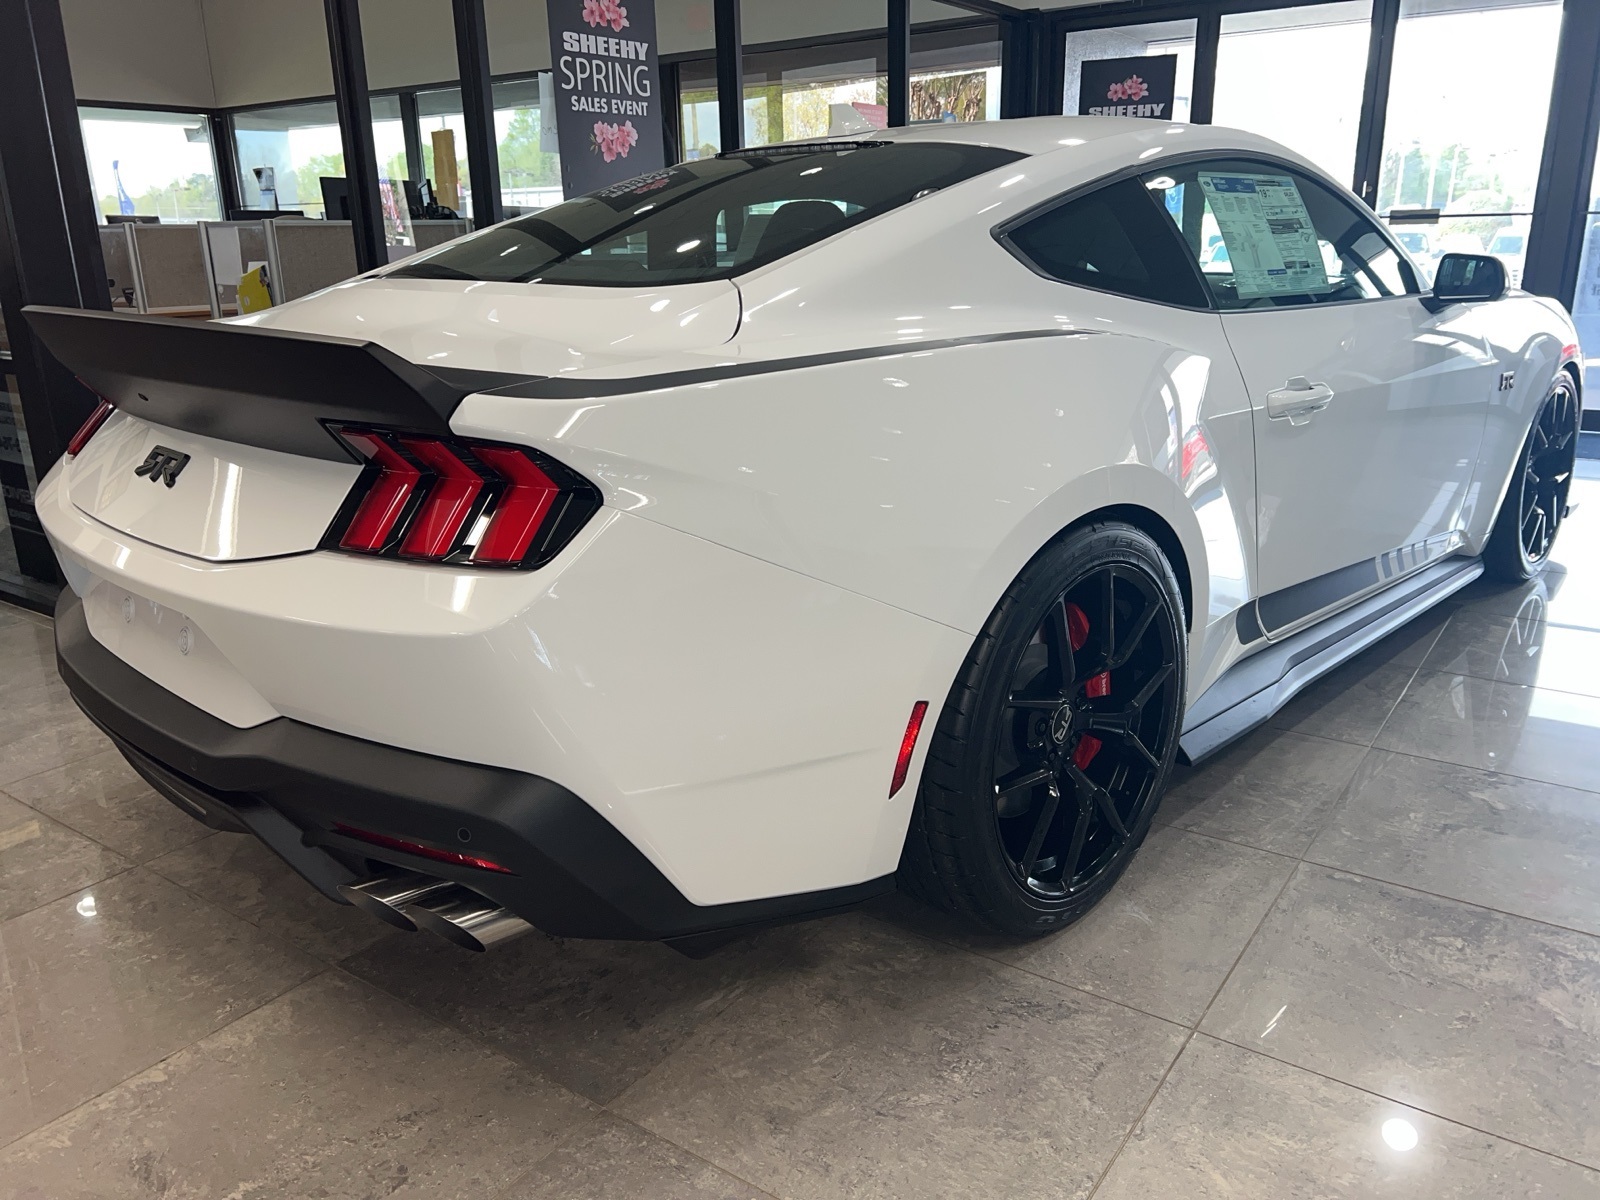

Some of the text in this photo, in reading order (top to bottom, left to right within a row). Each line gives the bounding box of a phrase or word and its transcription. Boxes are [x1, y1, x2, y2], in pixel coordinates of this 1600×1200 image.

[562, 31, 649, 61] SHEEHY
[559, 55, 651, 97] SPRING
[571, 95, 648, 116] SALES EVENT
[1088, 103, 1165, 117] SHEEHY
